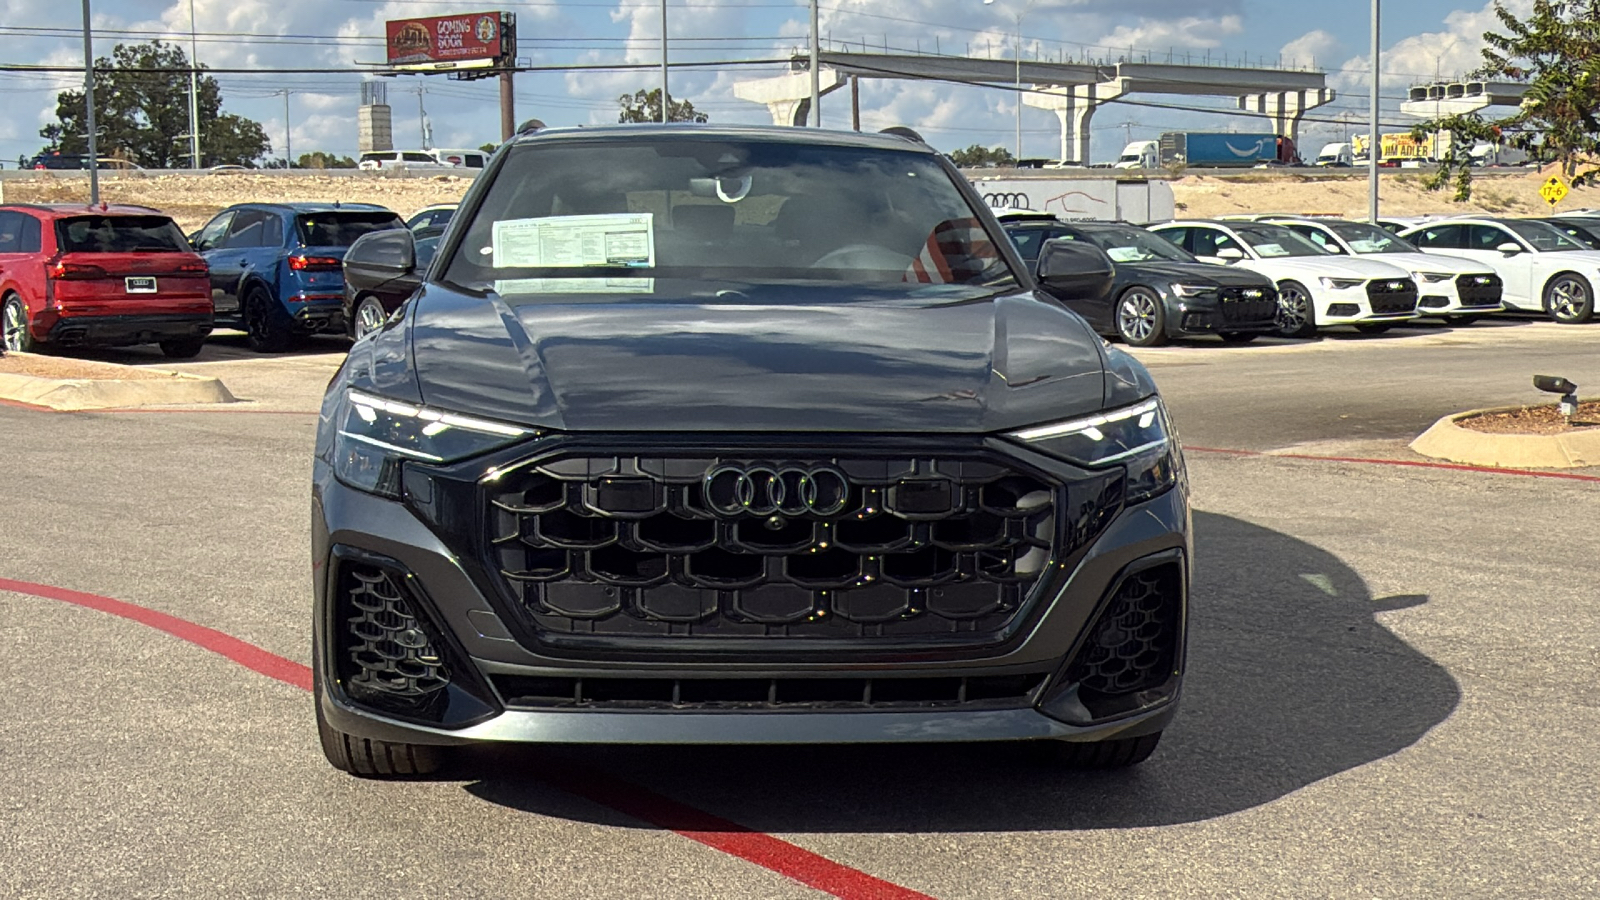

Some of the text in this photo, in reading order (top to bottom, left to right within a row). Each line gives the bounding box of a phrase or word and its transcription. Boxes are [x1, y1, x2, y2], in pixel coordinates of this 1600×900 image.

[437, 18, 471, 34] COMING
[438, 34, 463, 49] SOON
[1385, 144, 1427, 156] JIM ADLER
